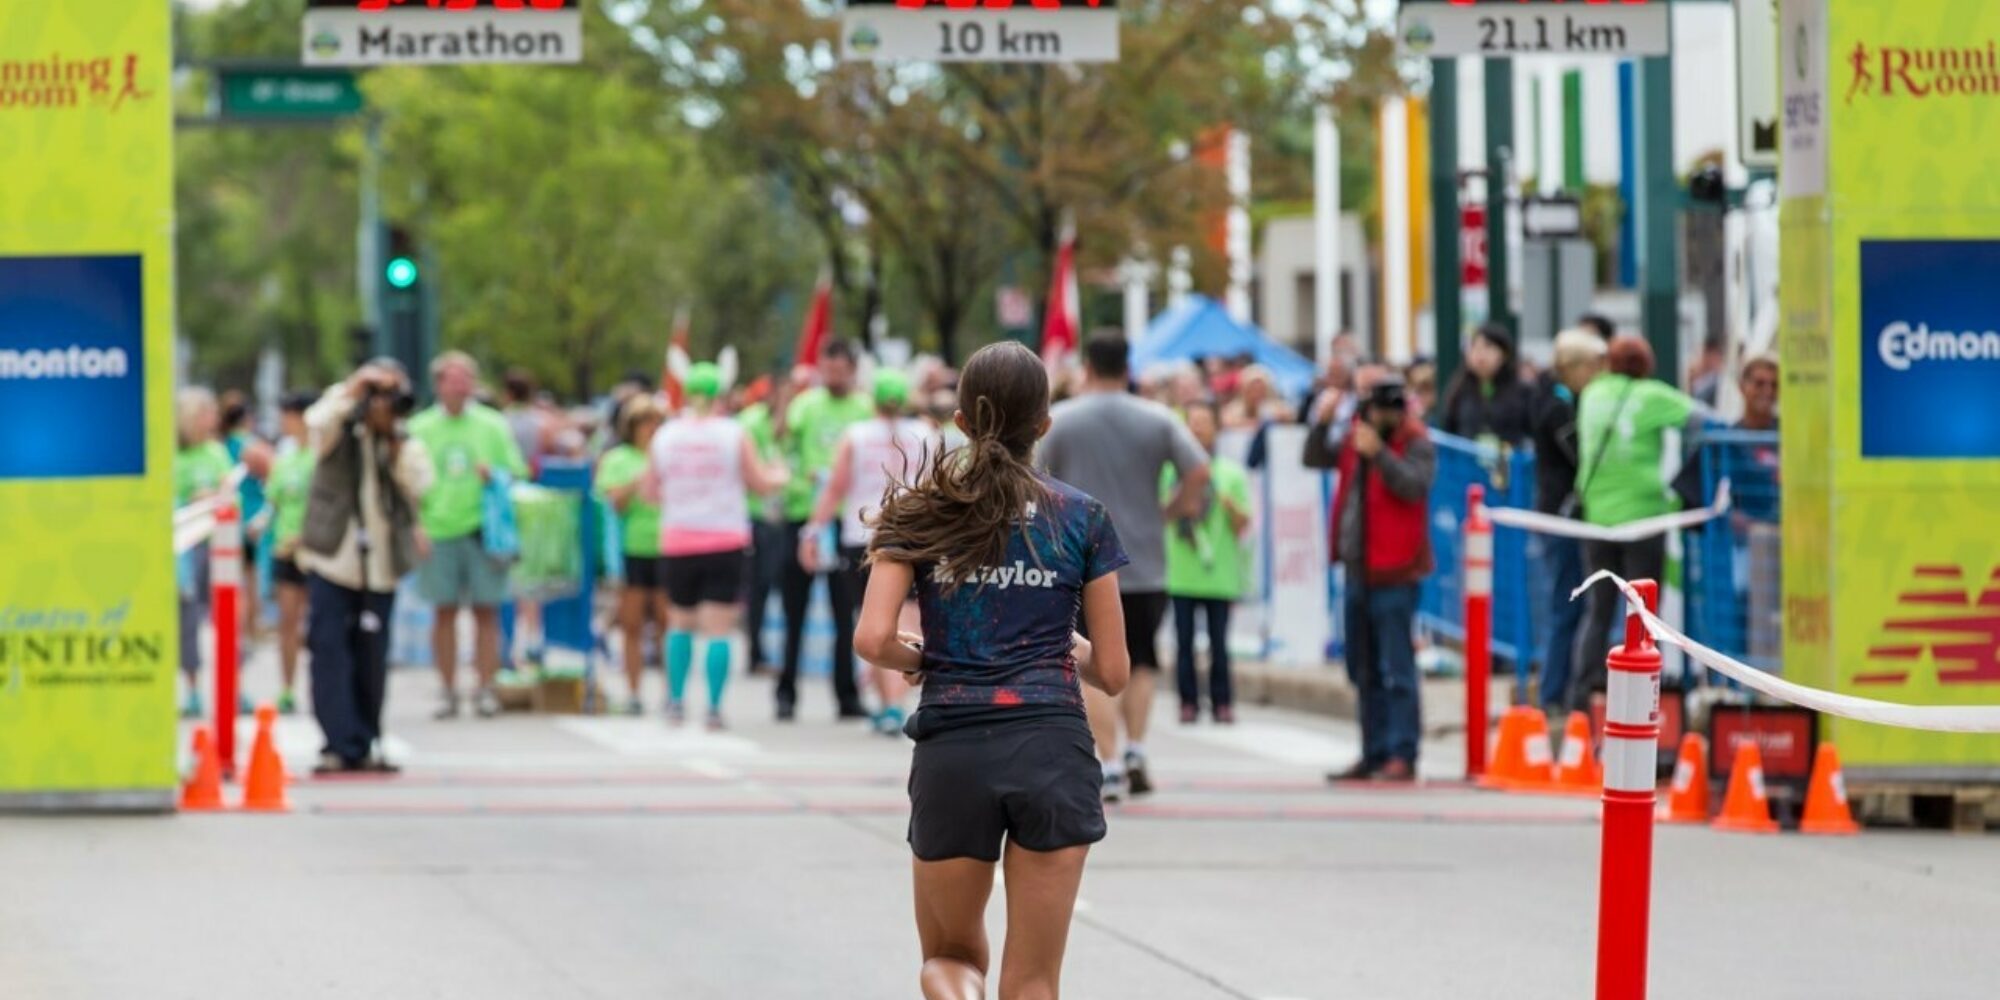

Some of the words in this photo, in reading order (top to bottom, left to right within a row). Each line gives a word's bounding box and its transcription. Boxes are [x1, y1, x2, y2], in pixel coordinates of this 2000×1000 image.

[357, 23, 564, 56] Marathon
[939, 22, 984, 54] 10
[999, 20, 1061, 54] km
[1478, 17, 1552, 51] 21.1
[1565, 15, 1626, 50] km
